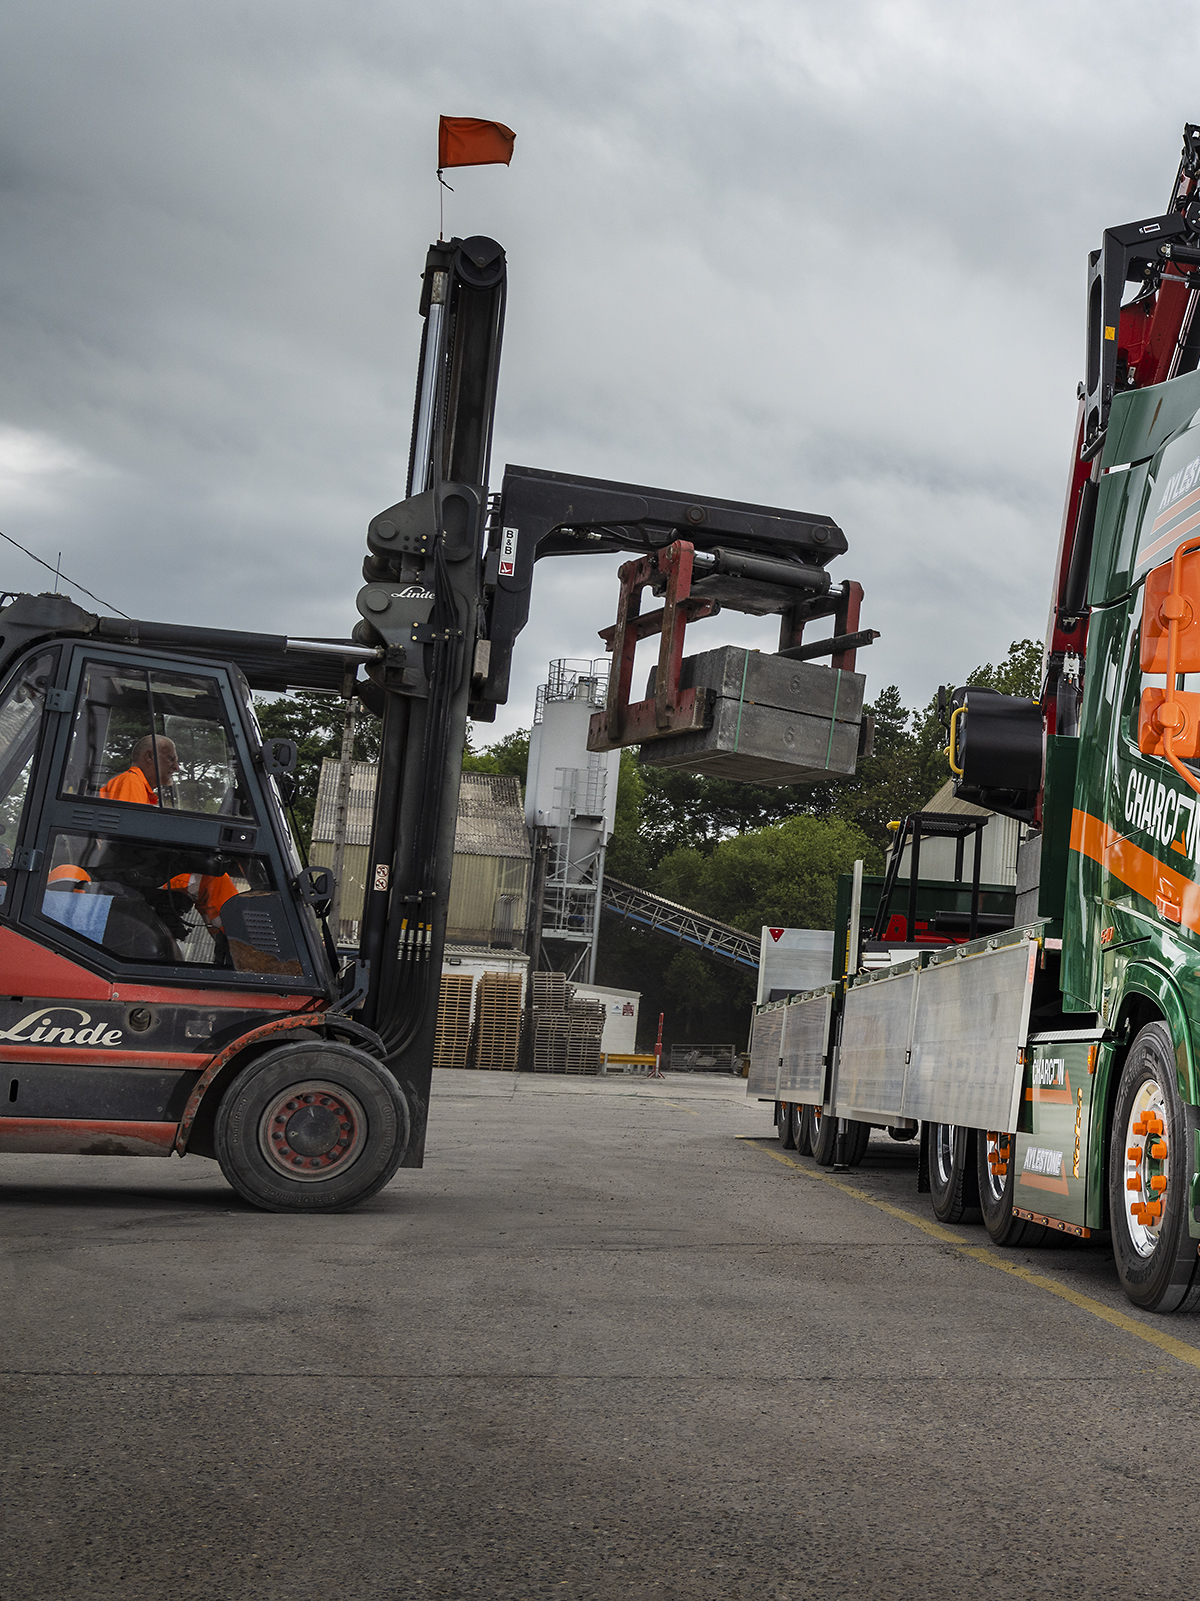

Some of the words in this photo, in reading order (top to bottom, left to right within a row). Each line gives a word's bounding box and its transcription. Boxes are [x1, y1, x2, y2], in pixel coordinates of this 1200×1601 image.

[391, 585, 436, 600] Linde
[0, 1006, 123, 1046] Linde
[1023, 1146, 1063, 1176] AYLESTONE
